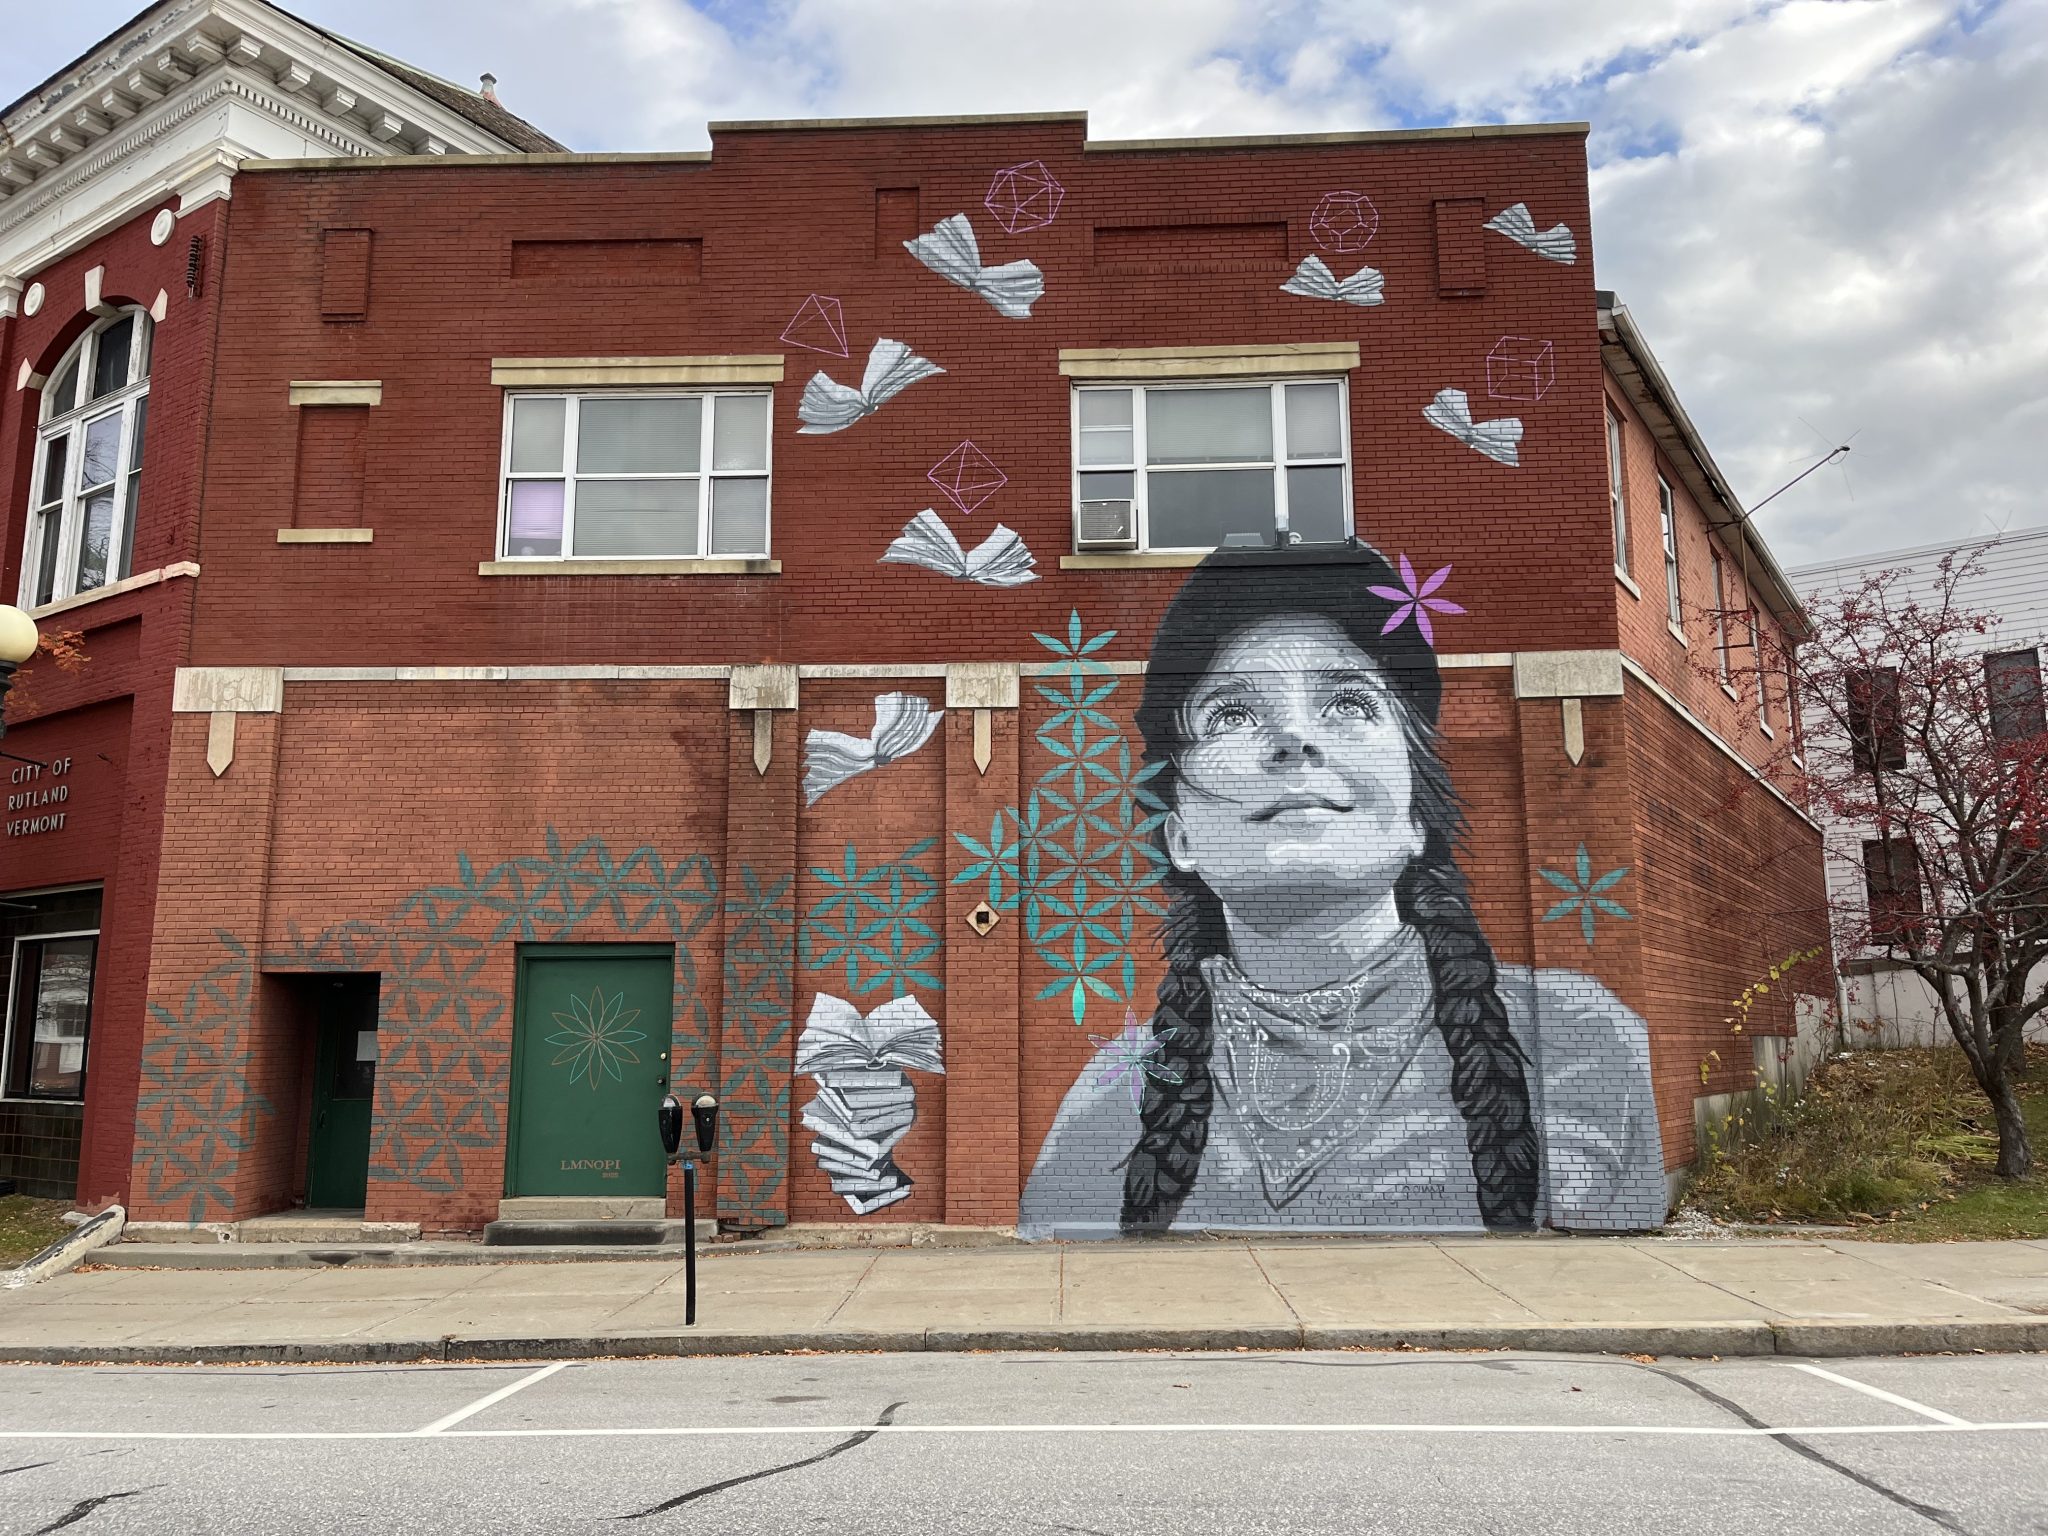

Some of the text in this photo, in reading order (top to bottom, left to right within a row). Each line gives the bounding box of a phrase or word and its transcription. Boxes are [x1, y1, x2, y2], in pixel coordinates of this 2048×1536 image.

[11, 757, 72, 784] CITY OF
[8, 785, 68, 811] RUTLAND
[6, 813, 67, 836] VERMONT
[560, 1160, 621, 1170] LMNOPI
